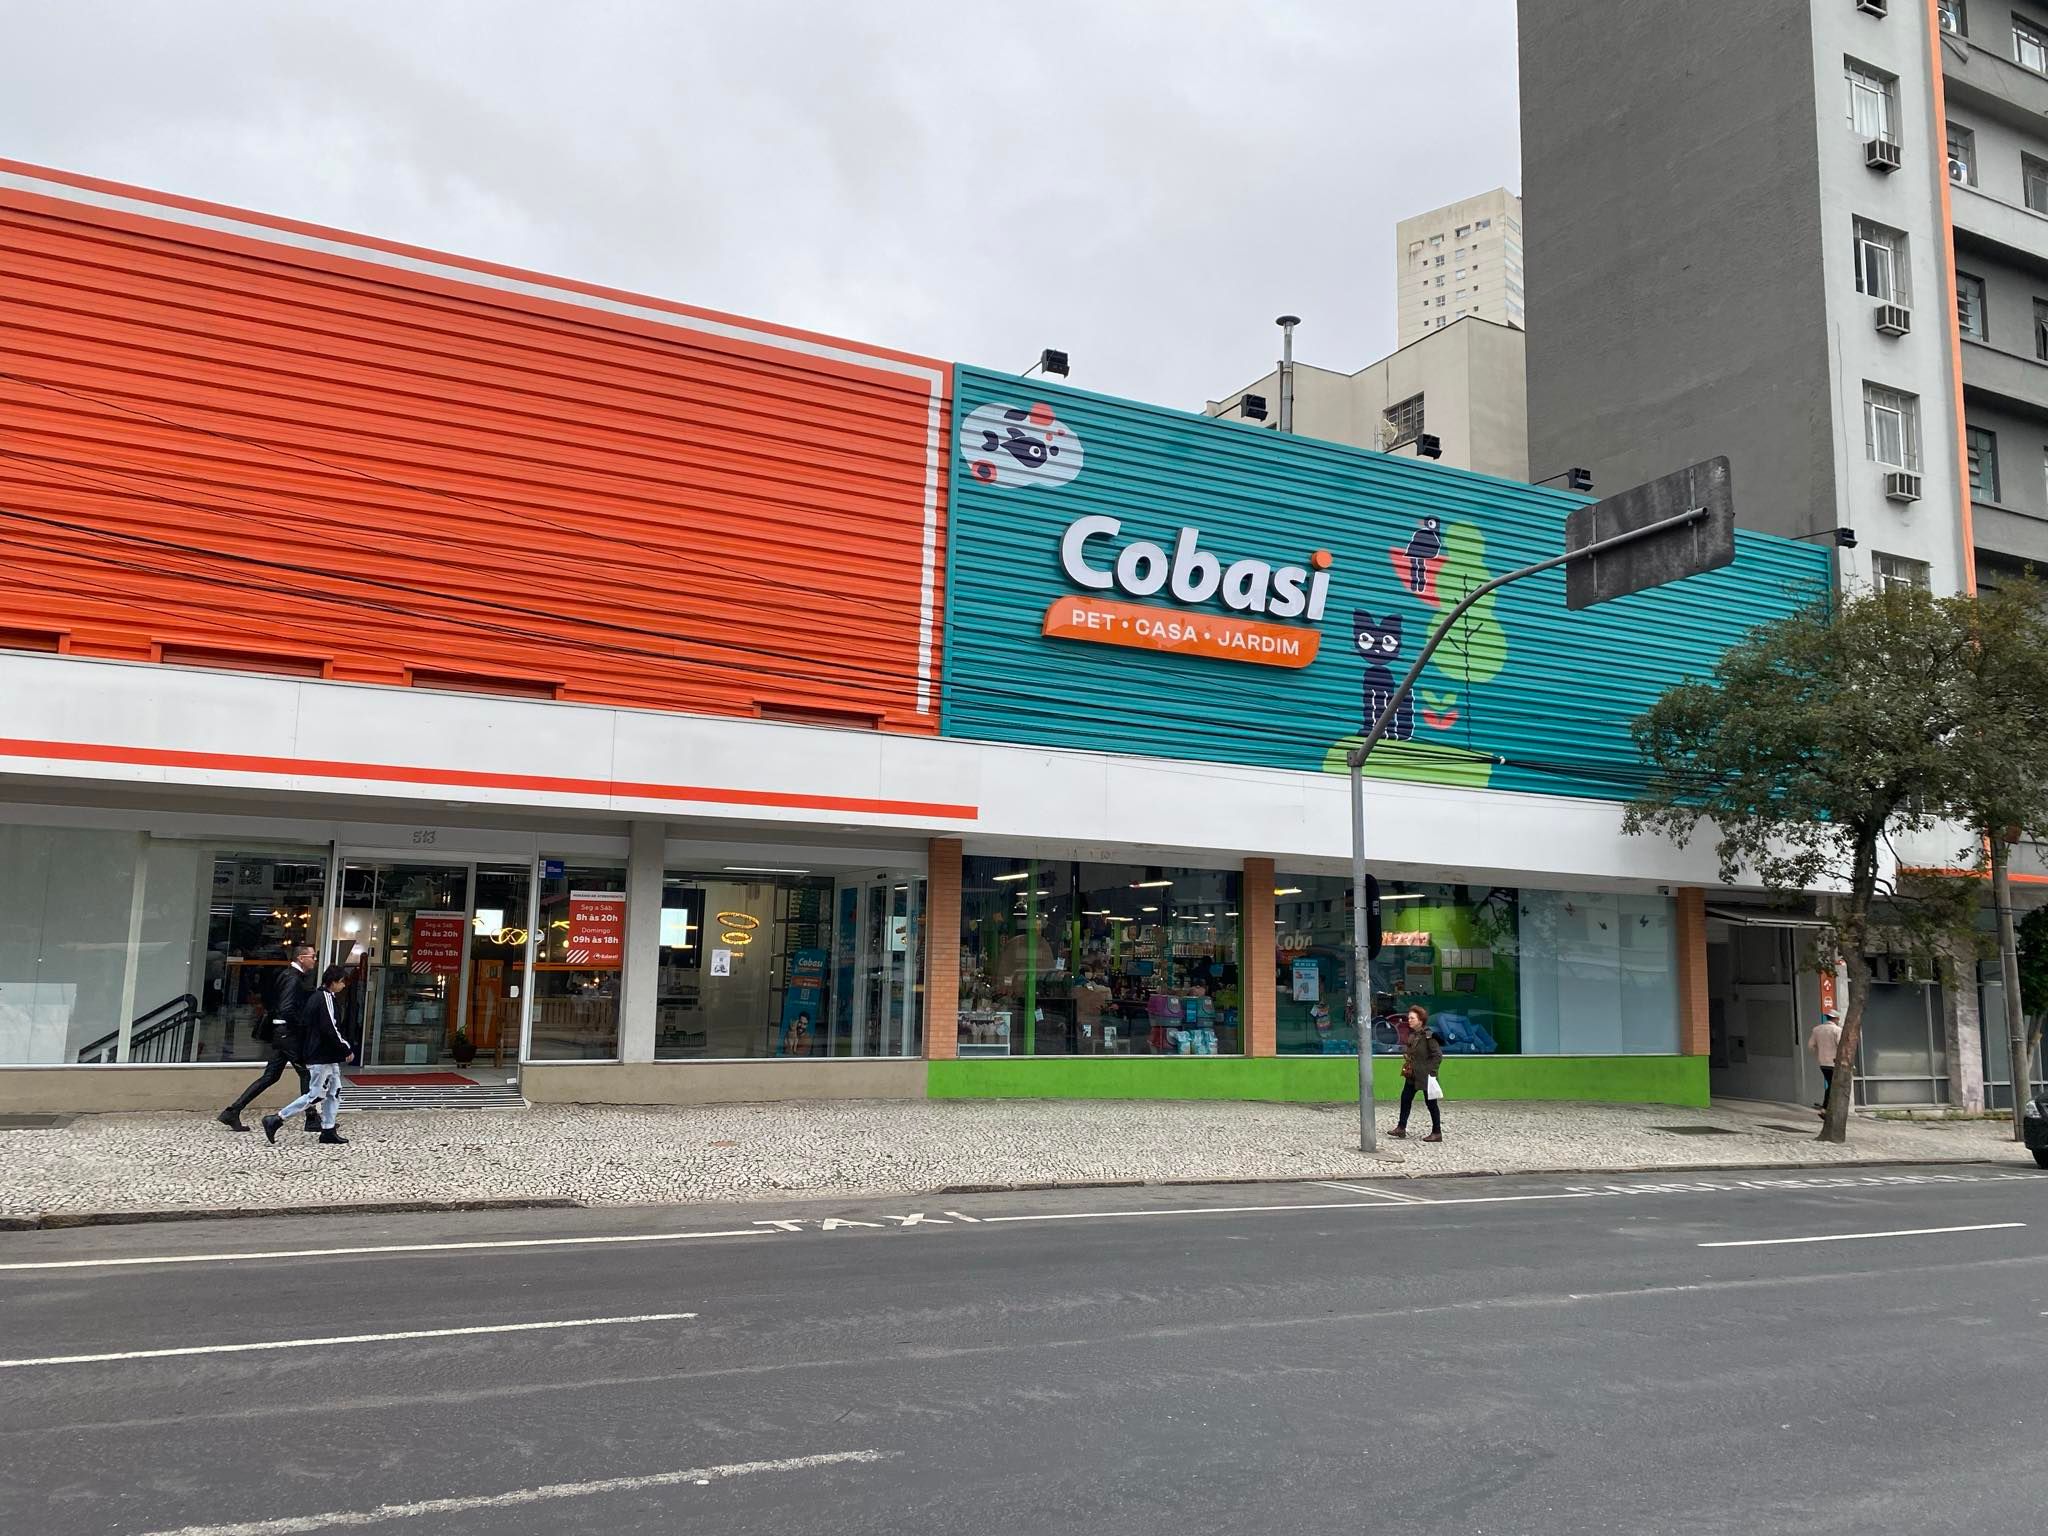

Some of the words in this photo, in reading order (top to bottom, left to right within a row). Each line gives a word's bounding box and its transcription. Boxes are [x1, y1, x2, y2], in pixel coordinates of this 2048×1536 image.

[1060, 515, 1333, 621] Cobasi
[1071, 608, 1116, 632] PET
[1136, 618, 1198, 643] CASA
[1217, 630, 1300, 657] JARDIM
[576, 913, 588, 921] 8h
[589, 913, 600, 921] às
[601, 914, 618, 922] 20h
[581, 927, 611, 935] Domingo
[572, 935, 590, 943] 09h
[591, 935, 602, 943] às
[603, 936, 619, 944] 18h
[444, 949, 459, 957] 18h
[752, 1211, 982, 1232] TAXI
